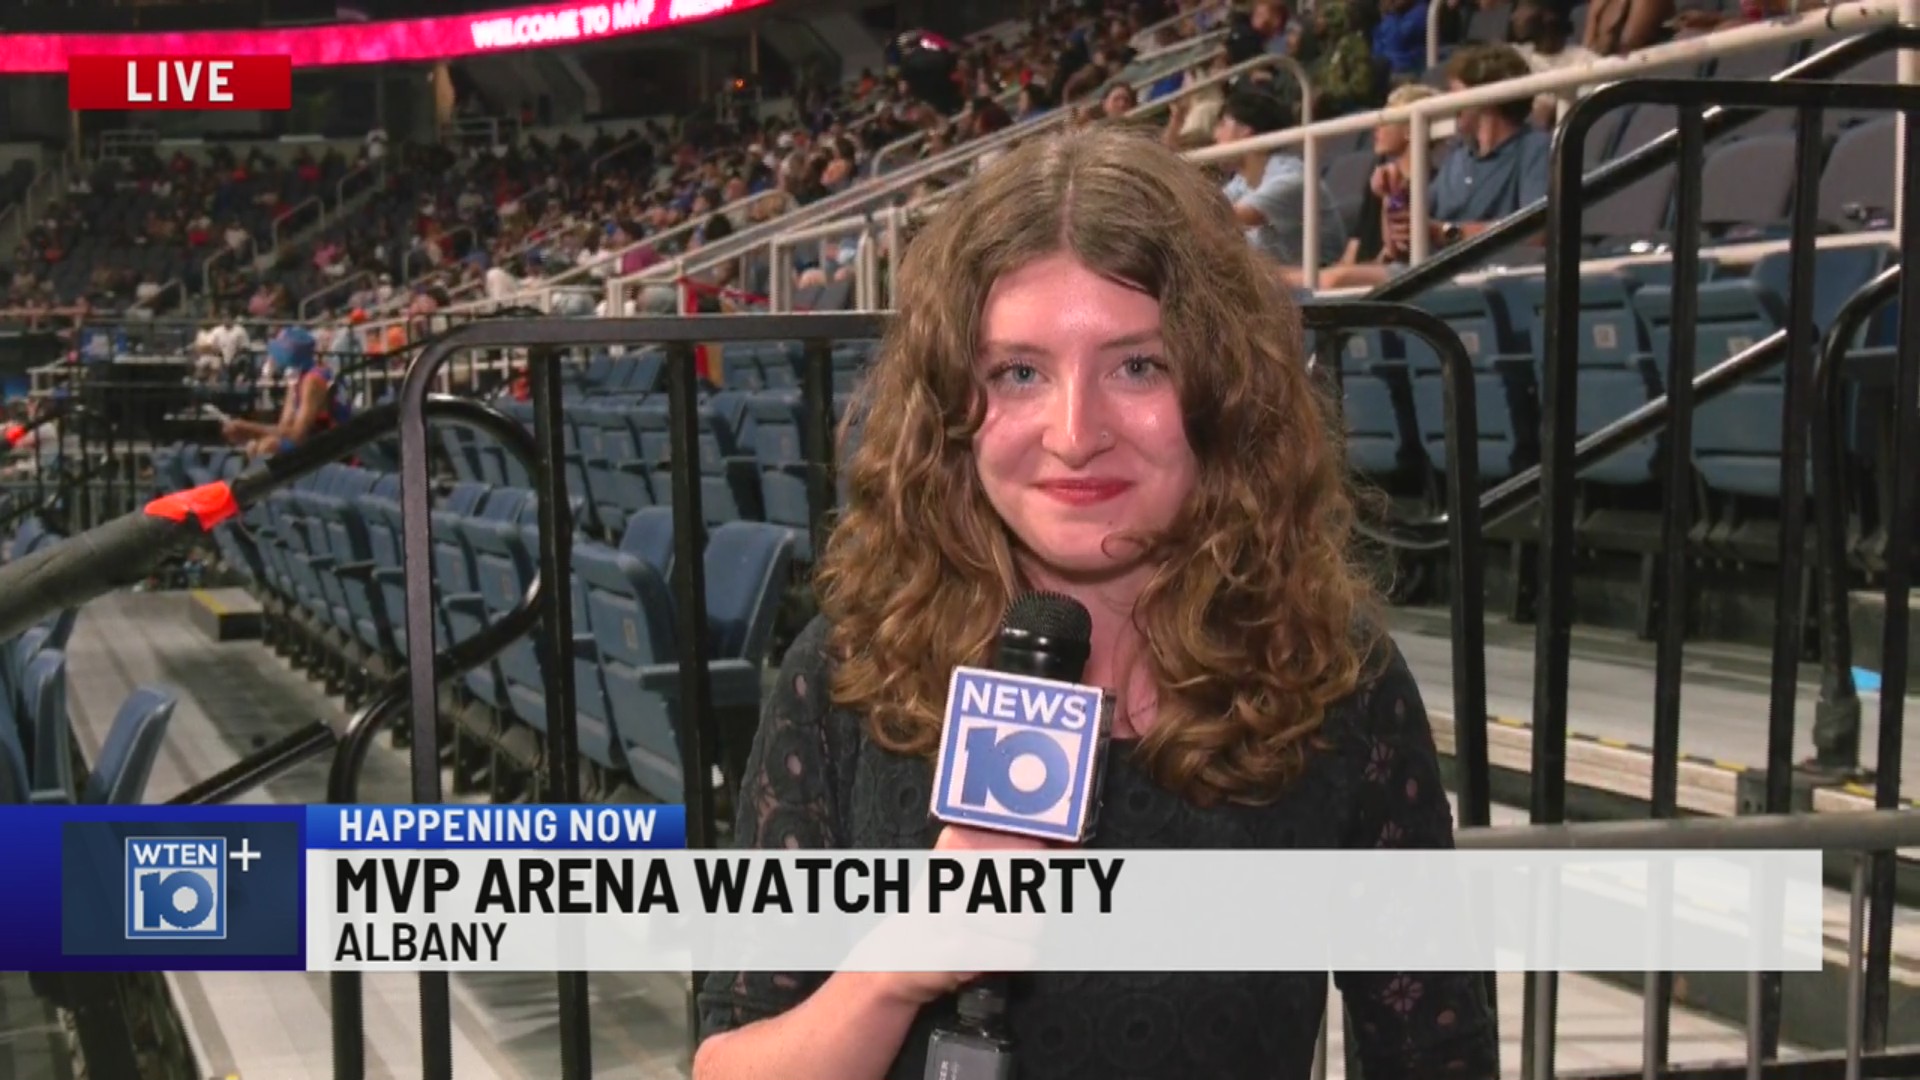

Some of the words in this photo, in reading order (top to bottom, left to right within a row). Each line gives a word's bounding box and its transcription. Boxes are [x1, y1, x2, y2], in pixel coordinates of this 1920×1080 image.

[471, 9, 580, 48] WELCOME
[580, 5, 610, 36] TO
[612, 0, 656, 30] MVP
[669, 0, 733, 19] ARE
[961, 680, 1087, 729] NEWS
[961, 727, 1070, 815] 10
